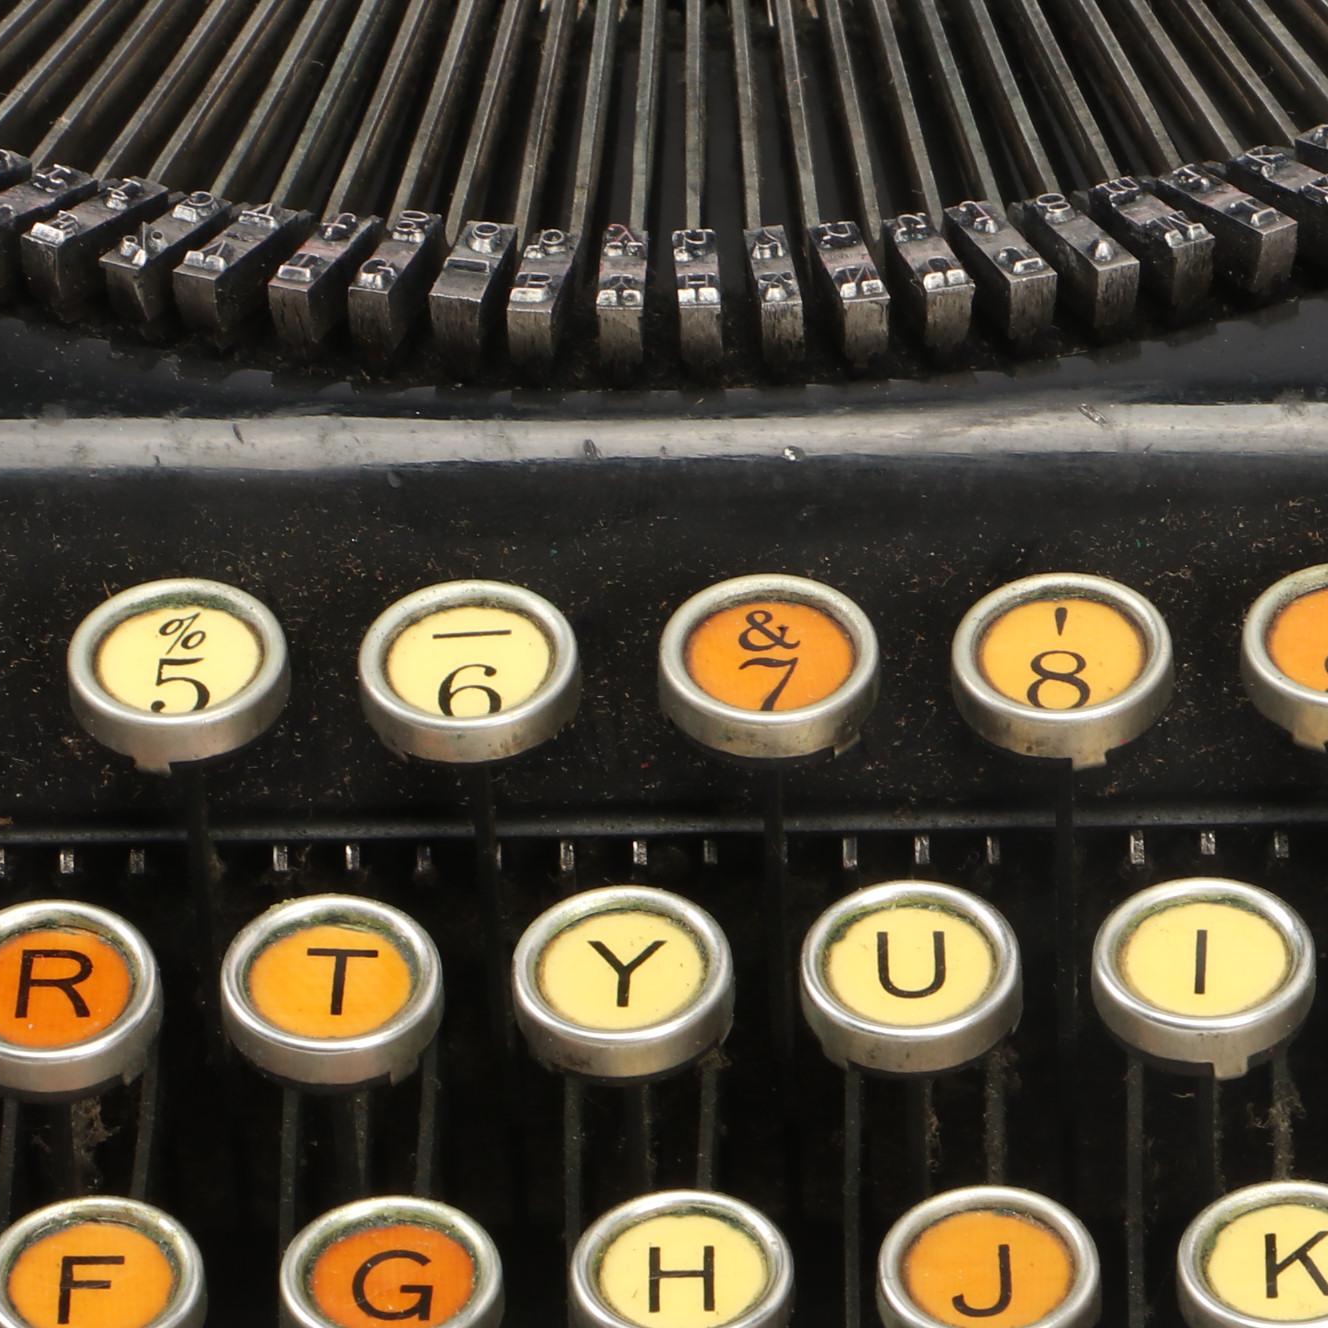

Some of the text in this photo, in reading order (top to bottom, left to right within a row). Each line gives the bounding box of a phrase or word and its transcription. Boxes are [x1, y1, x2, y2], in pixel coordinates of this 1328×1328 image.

[158, 612, 207, 654] %
[738, 610, 801, 652] &
[150, 658, 210, 714] 5
[437, 664, 502, 718] 6
[738, 657, 799, 712] 7
[1026, 650, 1091, 710] 8
[15, 949, 94, 1019] R
[306, 948, 379, 1016] T
[588, 940, 666, 1008] Y
[876, 931, 946, 999] U
[1193, 929, 1208, 995] I
[56, 1255, 126, 1325] F
[351, 1249, 433, 1321] G
[648, 1245, 715, 1313] H
[951, 1244, 1012, 1318] J
